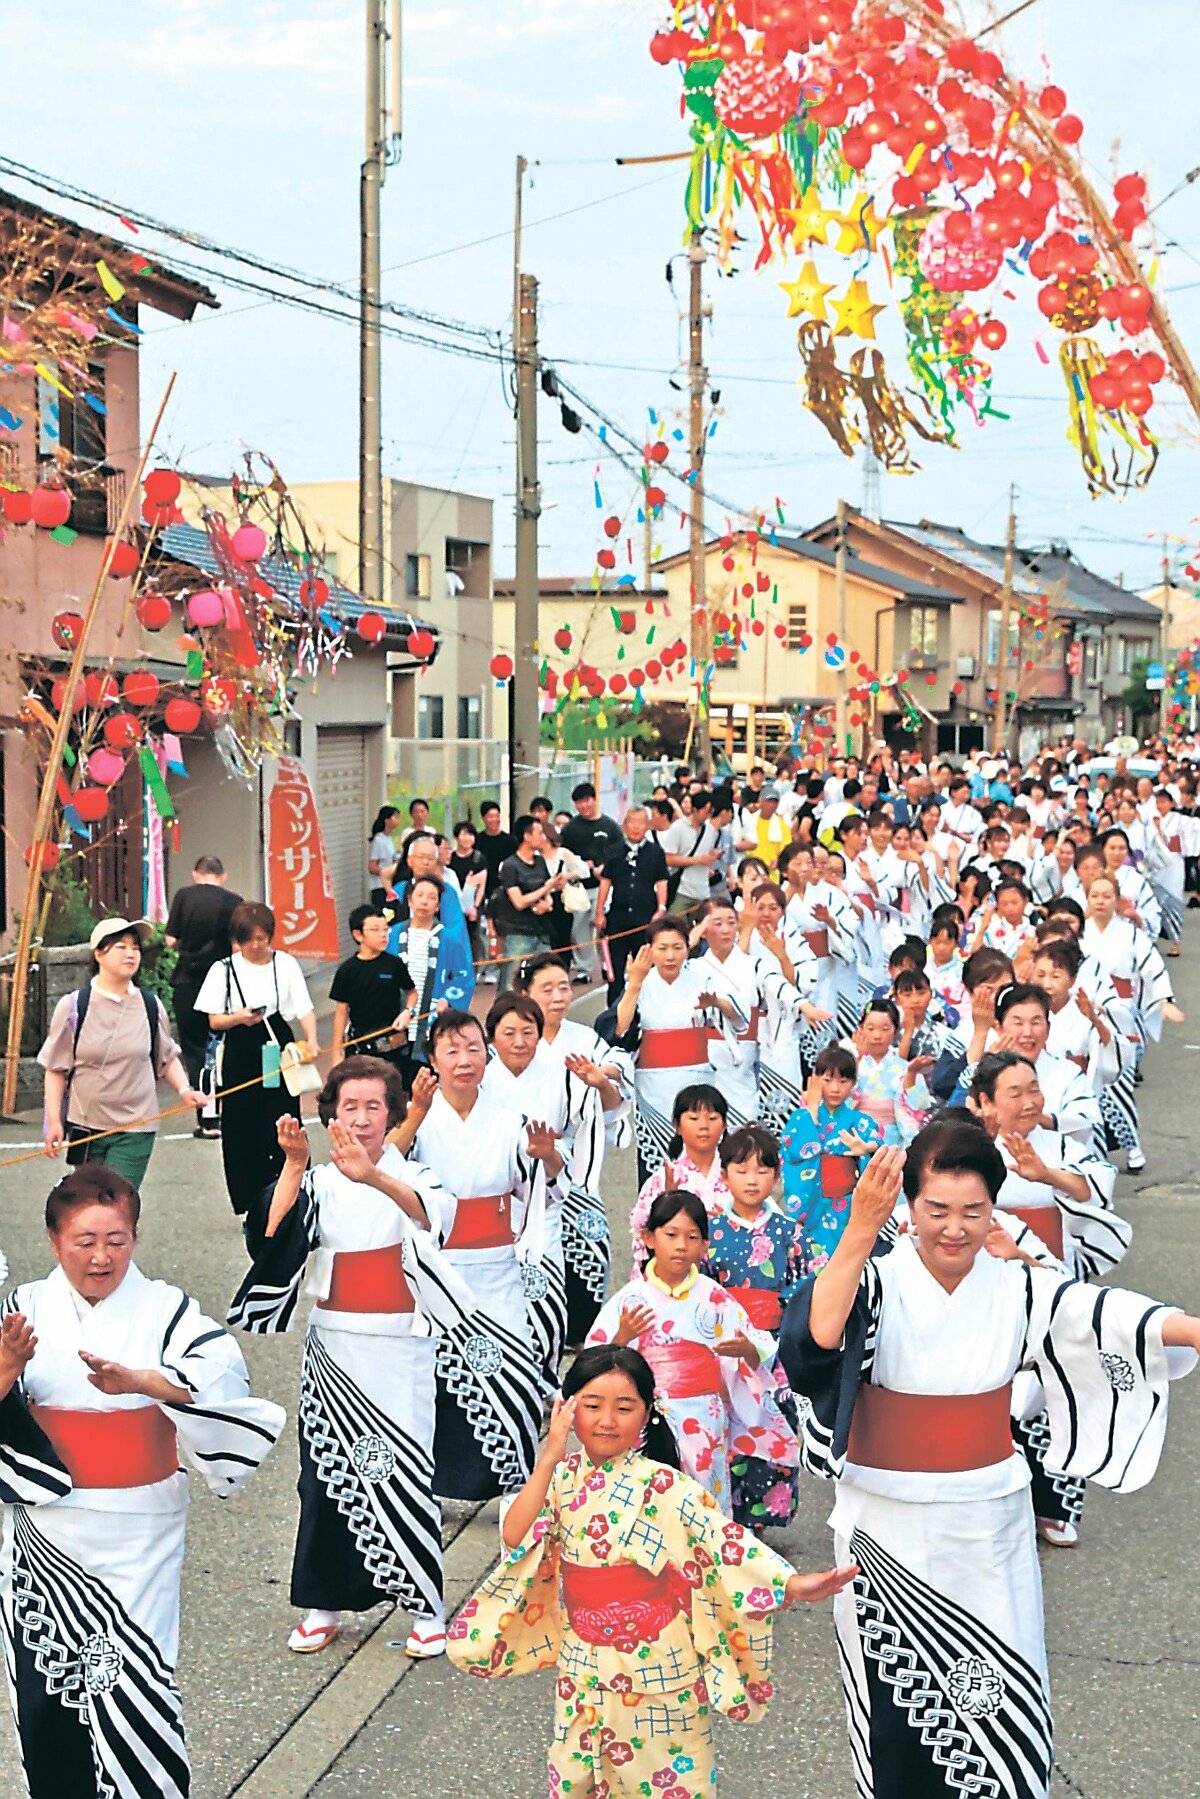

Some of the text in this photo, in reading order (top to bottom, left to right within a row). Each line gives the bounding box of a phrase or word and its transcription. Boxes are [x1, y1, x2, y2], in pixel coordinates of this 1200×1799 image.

[277, 788, 319, 945] マッサージ
